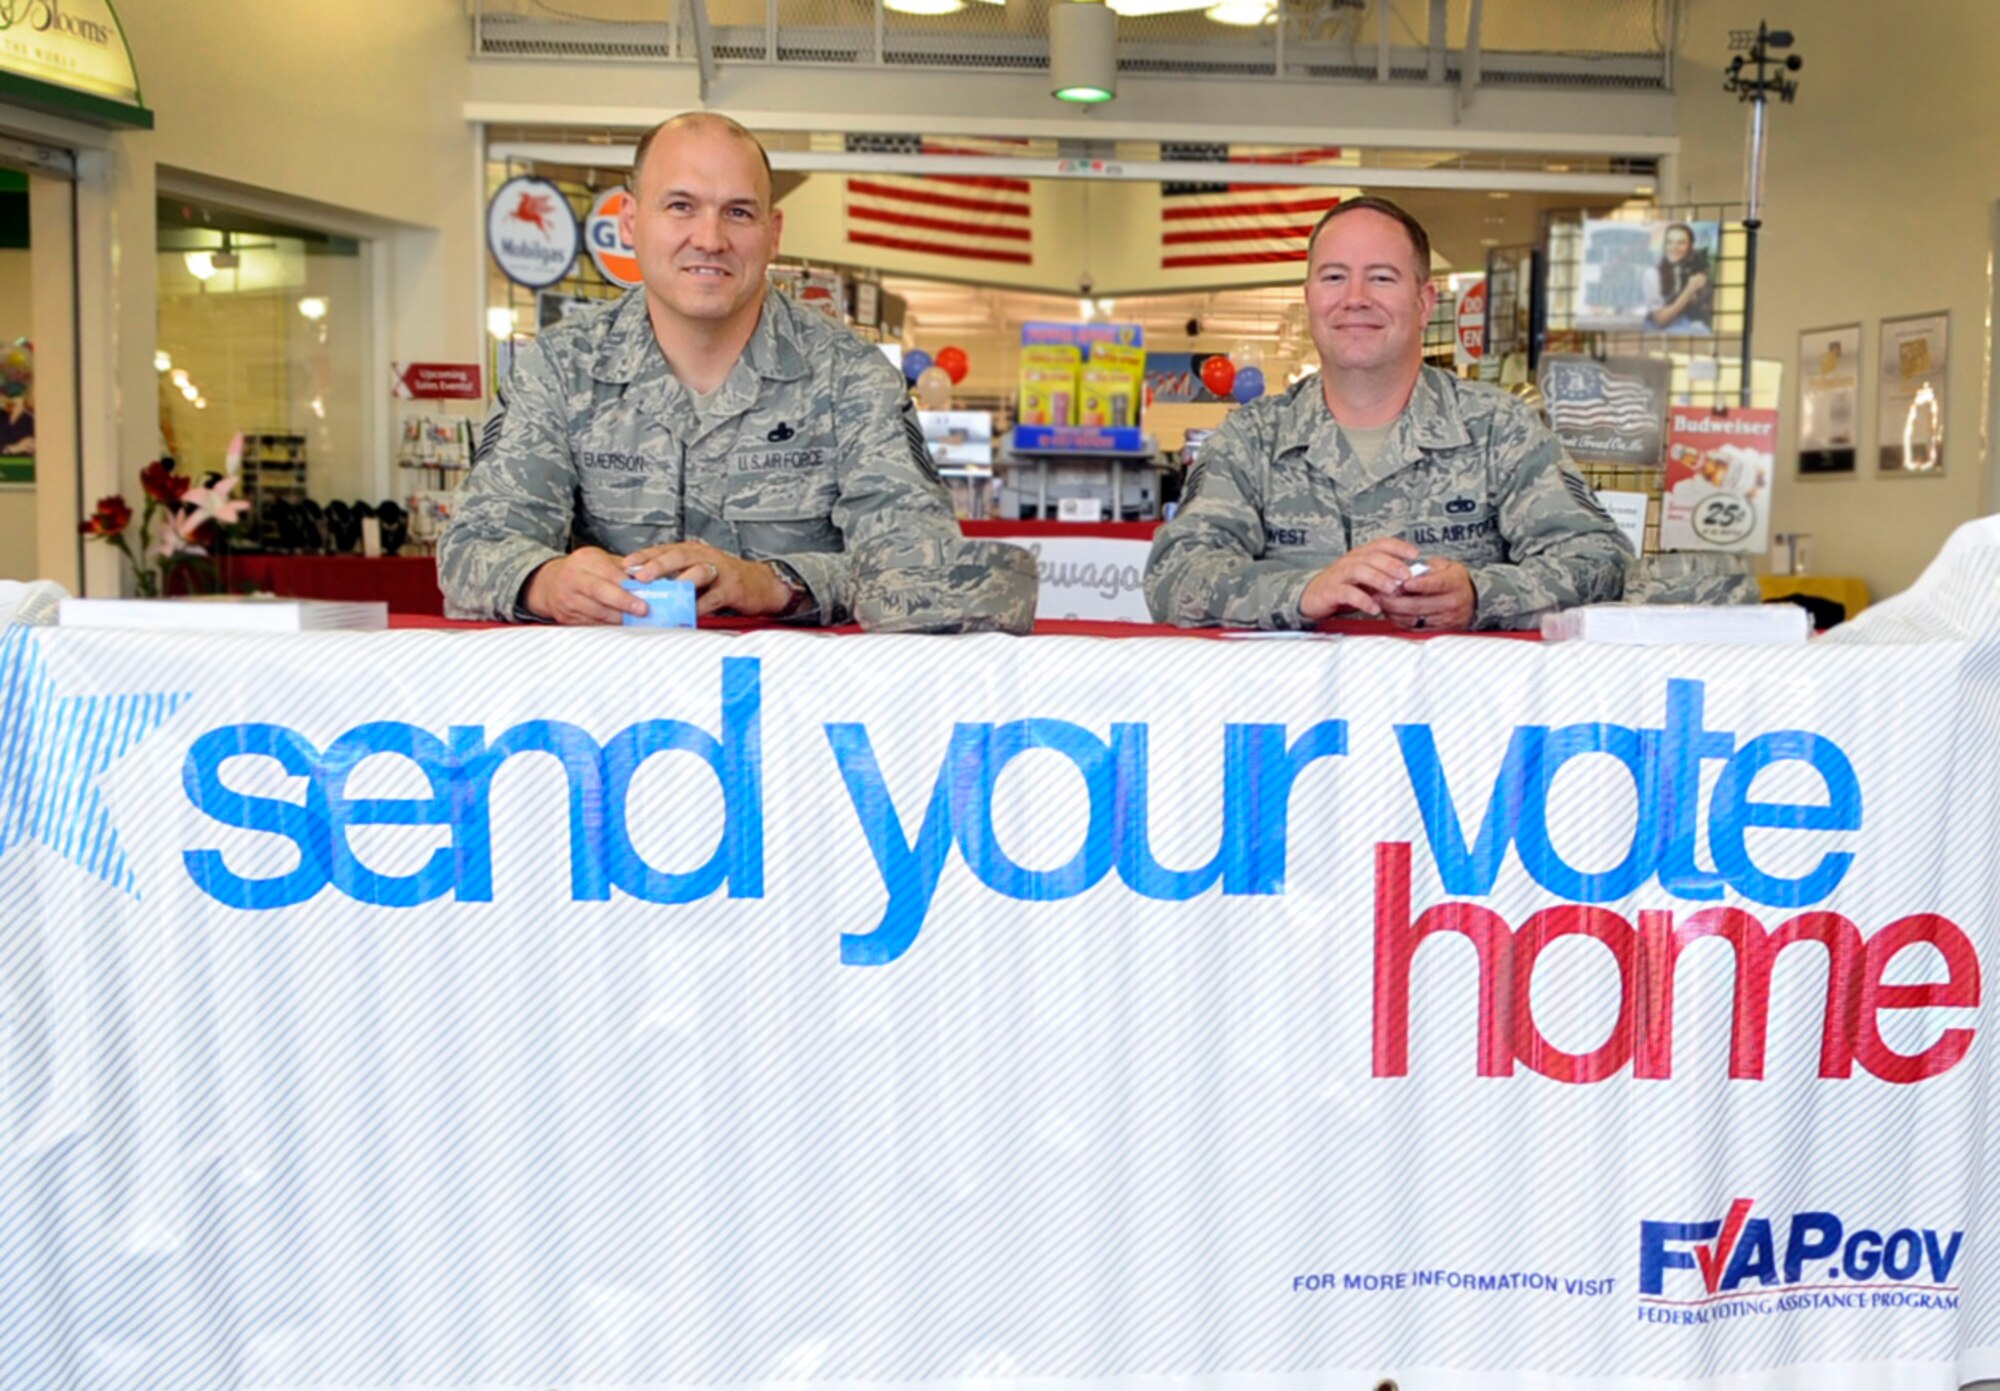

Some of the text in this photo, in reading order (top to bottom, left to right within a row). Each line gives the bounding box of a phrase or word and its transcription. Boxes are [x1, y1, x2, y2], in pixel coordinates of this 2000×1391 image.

[1674, 415, 1772, 435] Budweiser
[763, 452, 782, 469] AIR
[783, 450, 824, 469] FORCE
[1414, 527, 1440, 545] U.S.
[1441, 525, 1466, 542] AIR
[182, 656, 1863, 966] send your vote
[1373, 841, 1982, 1085] home
[1293, 1270, 1616, 1296] FOR MORE INFORMATION VISIT
[1638, 1306, 1709, 1325] FEDERAL
[1777, 1292, 1866, 1313] ASSISTANCE
[1871, 1292, 1958, 1310] PROGRAM
